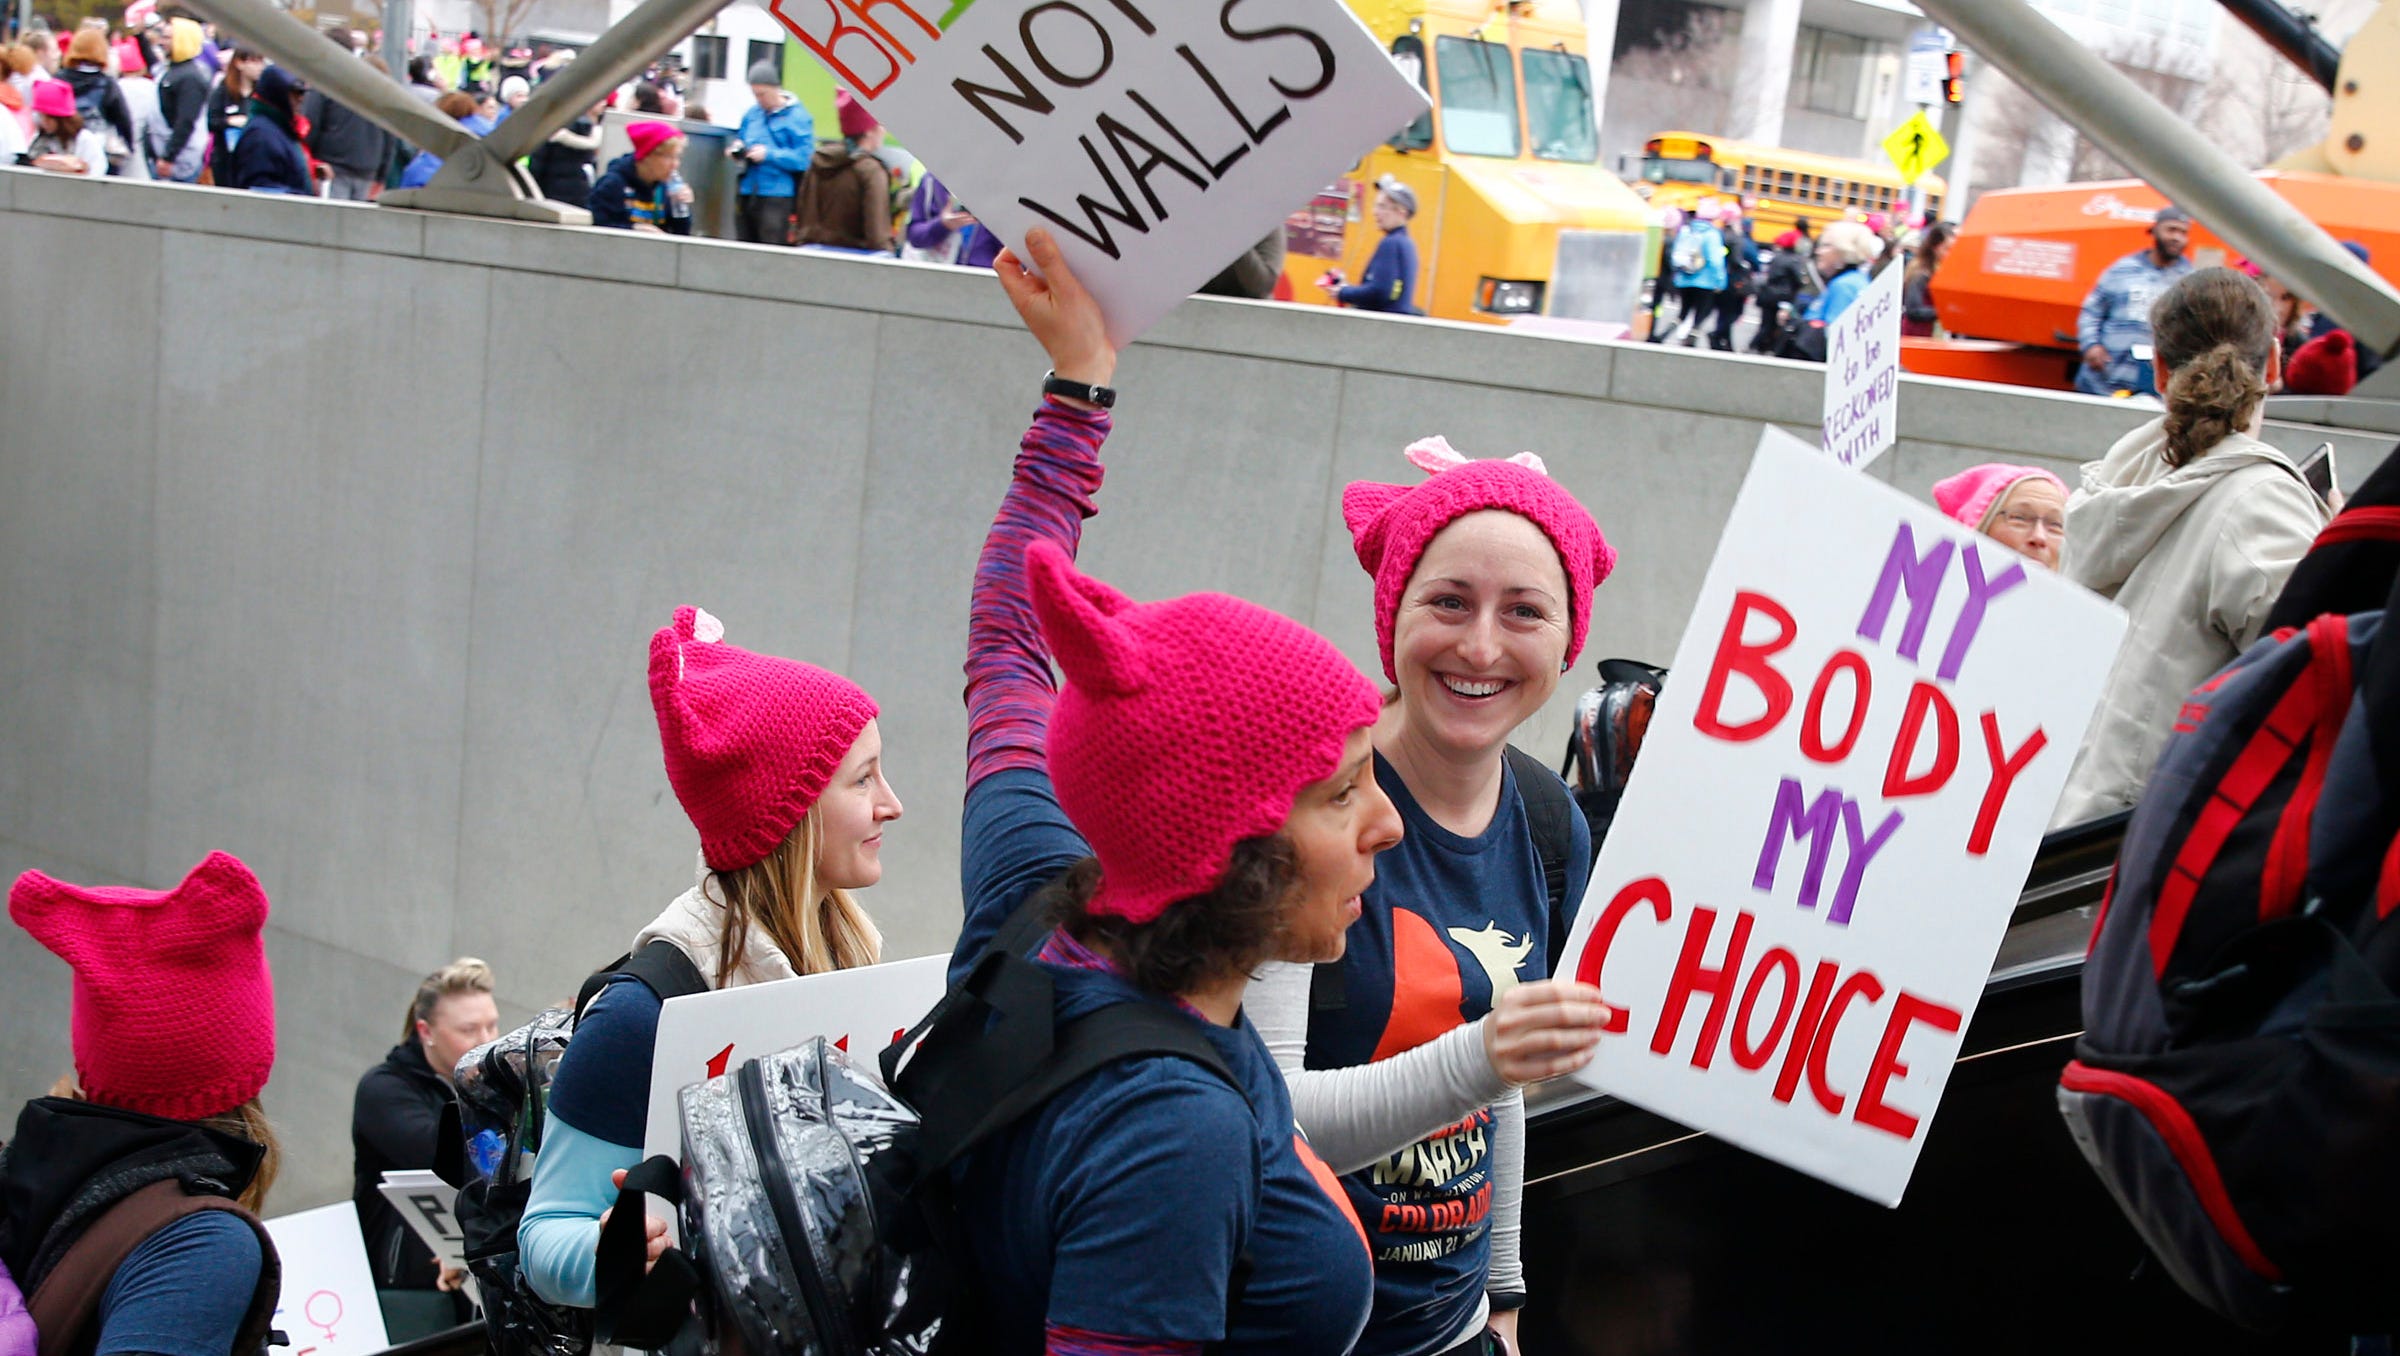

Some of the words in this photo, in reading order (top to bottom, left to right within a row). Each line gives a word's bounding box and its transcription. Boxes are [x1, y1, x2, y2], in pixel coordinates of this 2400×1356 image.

[769, 0, 978, 101] BR
[1018, 0, 1336, 260] WALLS
[1833, 325, 1846, 362] A
[1844, 357, 1859, 386] to
[1865, 340, 1881, 370] be
[1822, 364, 1895, 451] RECKONED
[1837, 417, 1880, 466] WITH
[1856, 521, 2027, 682] MY
[1693, 589, 2048, 856] BODY
[1752, 776, 1905, 926] MY
[1575, 876, 1962, 1141] CHOICE
[1373, 1126, 1487, 1187] MARCH
[1378, 1181, 1492, 1232] COLORADO
[1378, 1239, 1443, 1262] JANUARY
